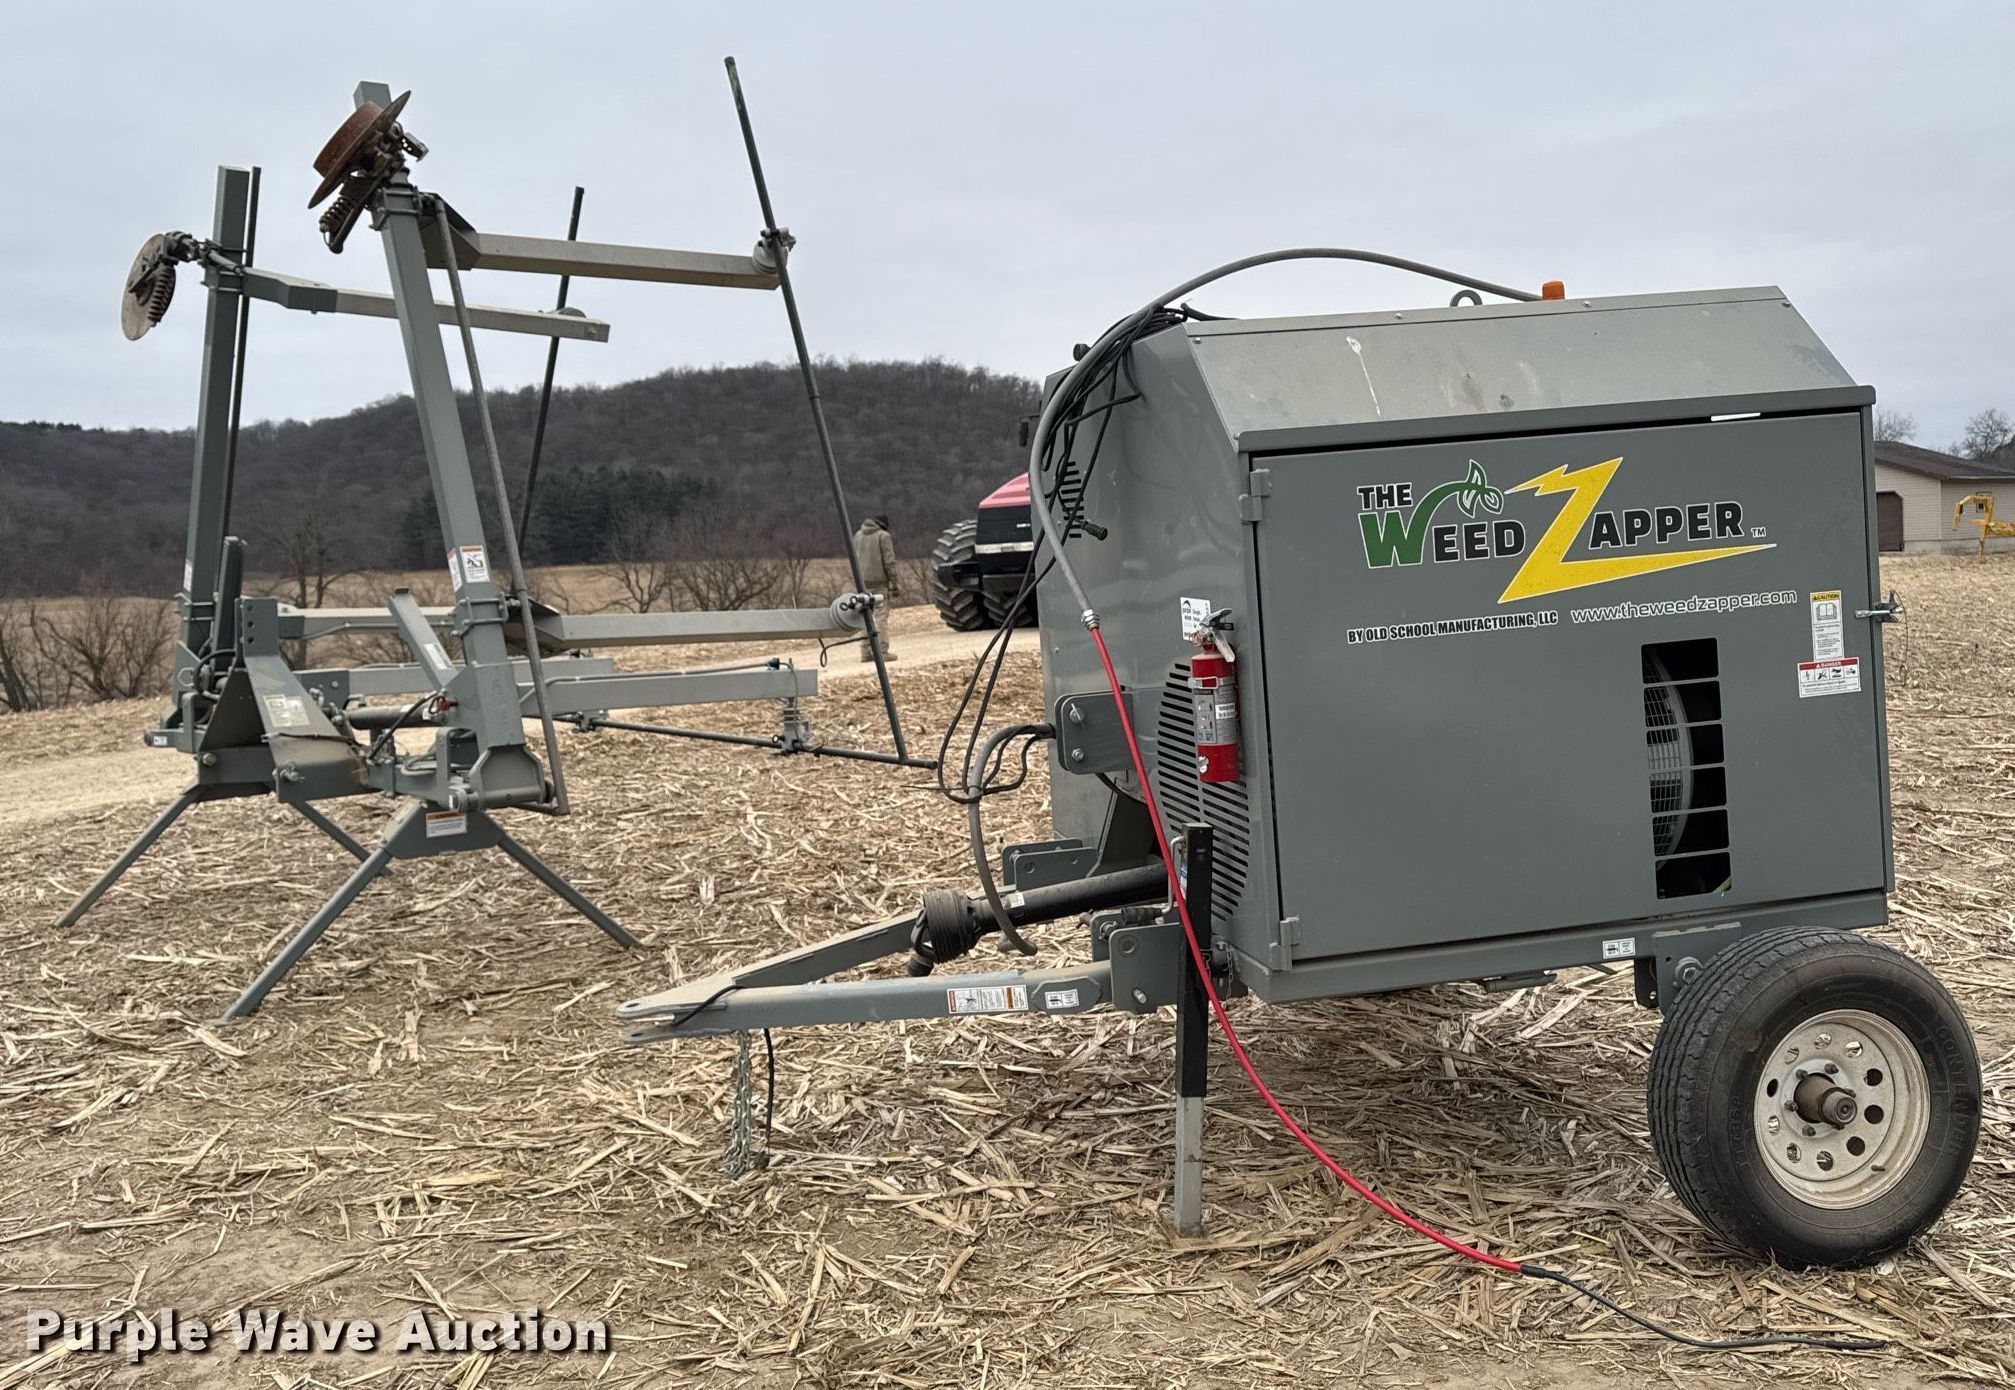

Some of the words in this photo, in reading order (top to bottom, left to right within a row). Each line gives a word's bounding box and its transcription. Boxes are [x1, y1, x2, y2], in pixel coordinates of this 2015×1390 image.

[1357, 482, 1413, 511] THE
[1358, 481, 1526, 569] WEED
[1570, 590, 1798, 624] www.theweedzapper.com
[1347, 629, 1365, 644] BY
[1365, 627, 1389, 642] OLD
[1389, 622, 1437, 640] SCHOOL
[1437, 612, 1538, 635] MANUFACTURING,
[1537, 610, 1559, 627] LLC
